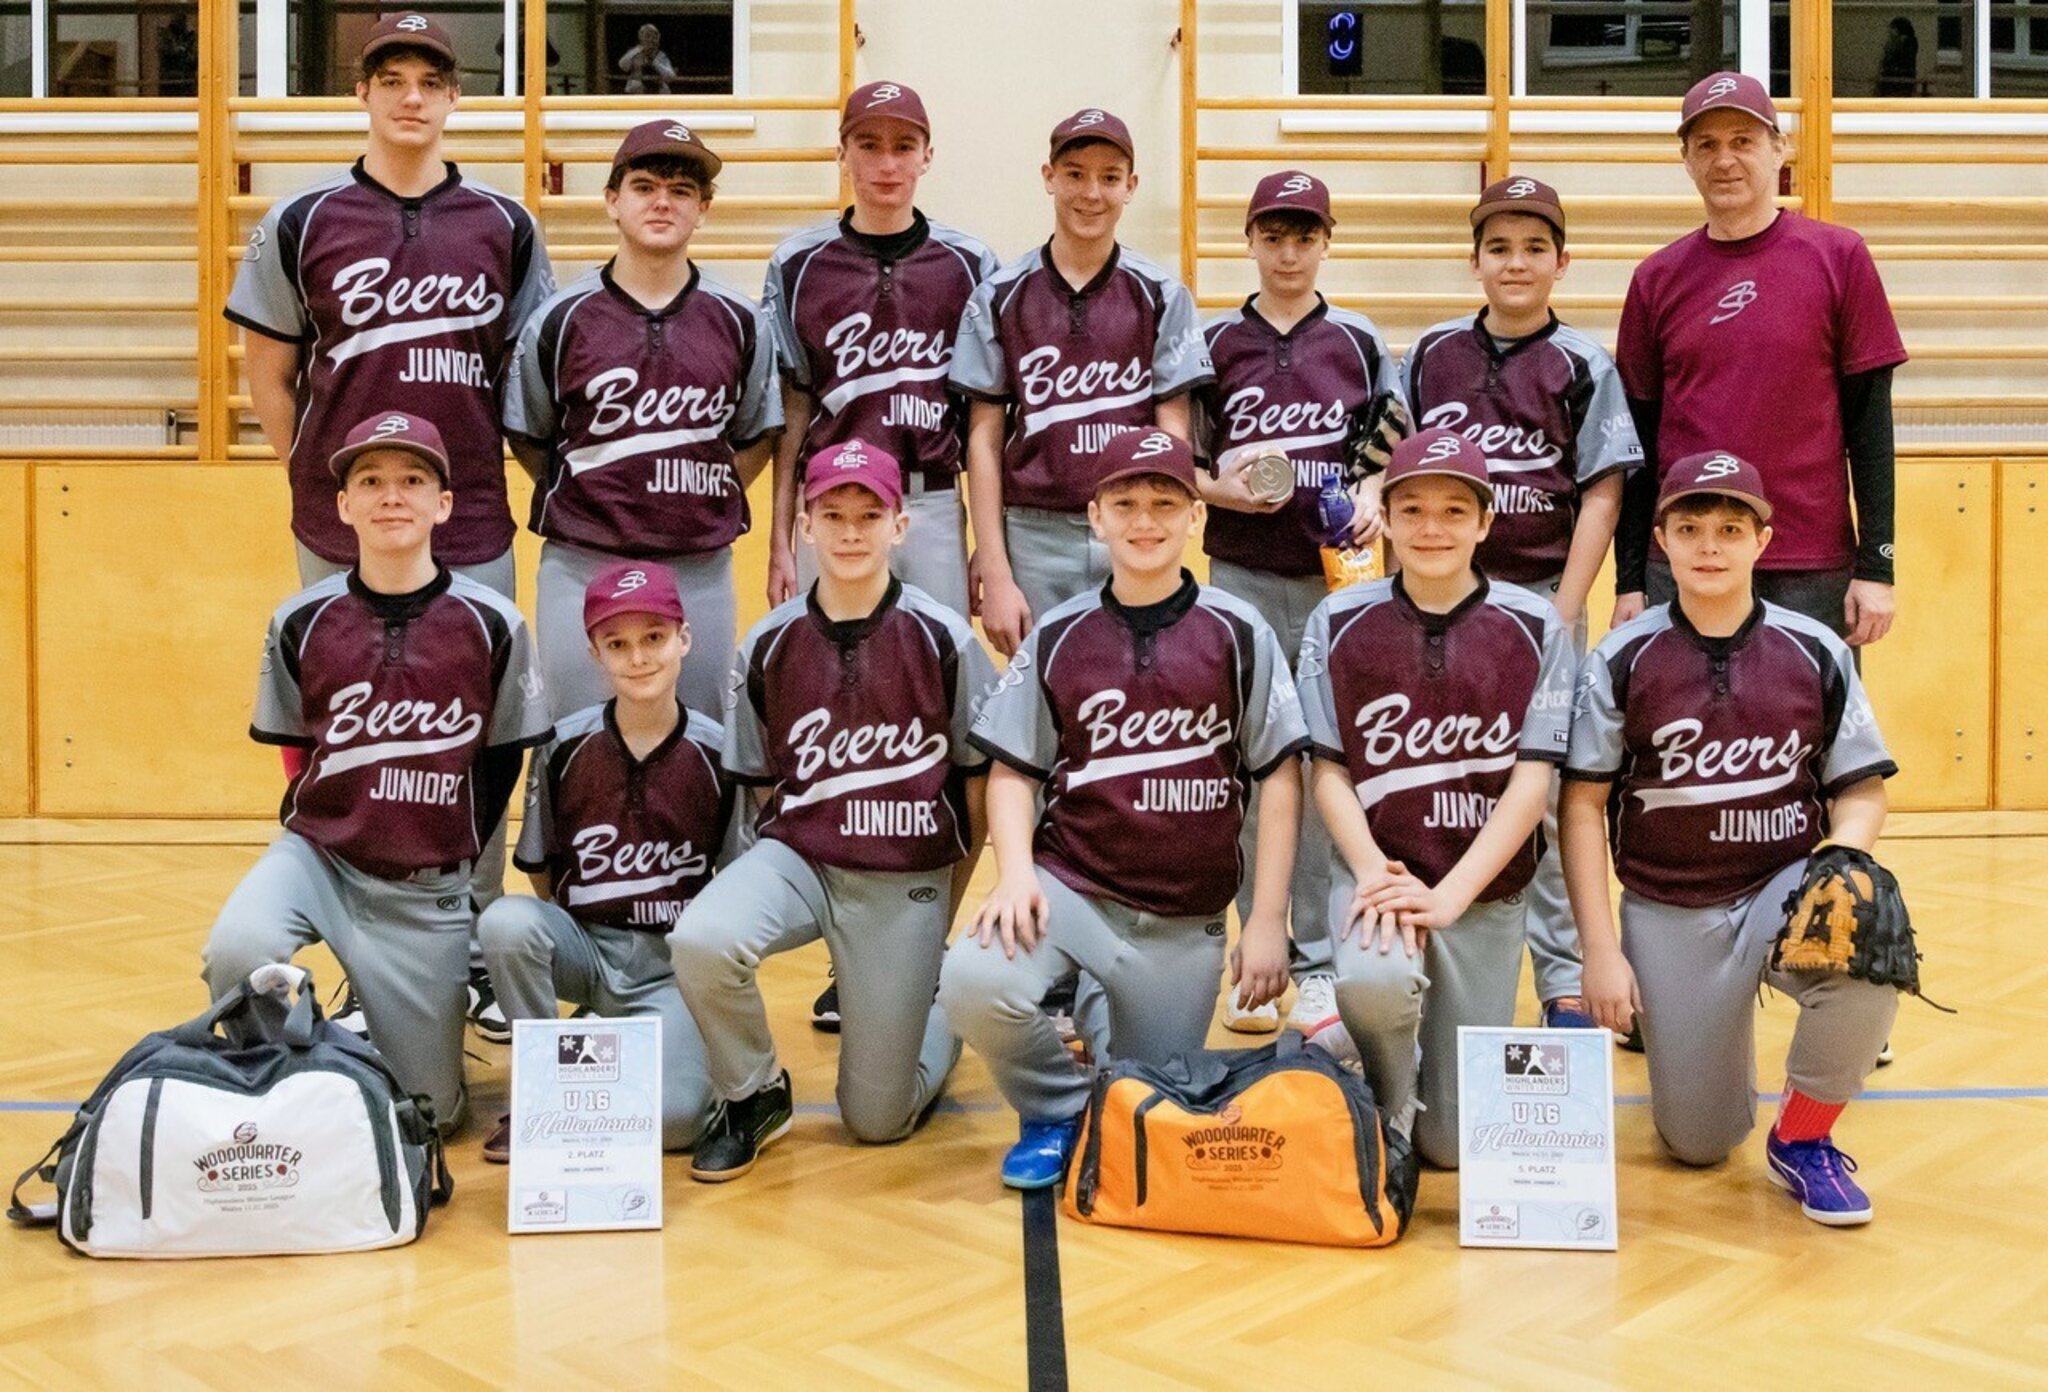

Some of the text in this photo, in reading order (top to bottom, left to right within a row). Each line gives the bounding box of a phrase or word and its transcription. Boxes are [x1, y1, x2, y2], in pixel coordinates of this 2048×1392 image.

[332, 257, 503, 327] Beers
[825, 312, 953, 378] Beers
[400, 348, 491, 389] JUNIOR
[1019, 345, 1152, 405] Beers
[585, 367, 736, 436] Beers
[881, 394, 949, 432] JUNIOR
[1224, 386, 1352, 441] Beers
[326, 681, 482, 745] Beers
[1078, 689, 1232, 753] Beers
[1355, 693, 1521, 766] Beers
[788, 708, 948, 781] Beers
[1652, 718, 1812, 781] Beers
[1133, 777, 1230, 813] JUNIORS
[1710, 801, 1808, 843] JUNIORS
[572, 824, 707, 880] Beers
[559, 1065, 617, 1074] HIGHLANDERS
[1505, 1077, 1566, 1086] HIGHLANDERS
[564, 1089, 611, 1112] U 16
[1511, 1101, 1561, 1125] U 16
[521, 1110, 653, 1143] Hallenturnier
[1182, 1126, 1286, 1151] WOODQUARTER
[1469, 1122, 1606, 1153] Hallenturnier
[193, 1144, 302, 1172] WOODQUARTER
[577, 1150, 605, 1159] PLATZ
[1209, 1145, 1258, 1161] SERIES
[1527, 1165, 1556, 1174] PLATZ
[222, 1164, 273, 1181] SERIES
